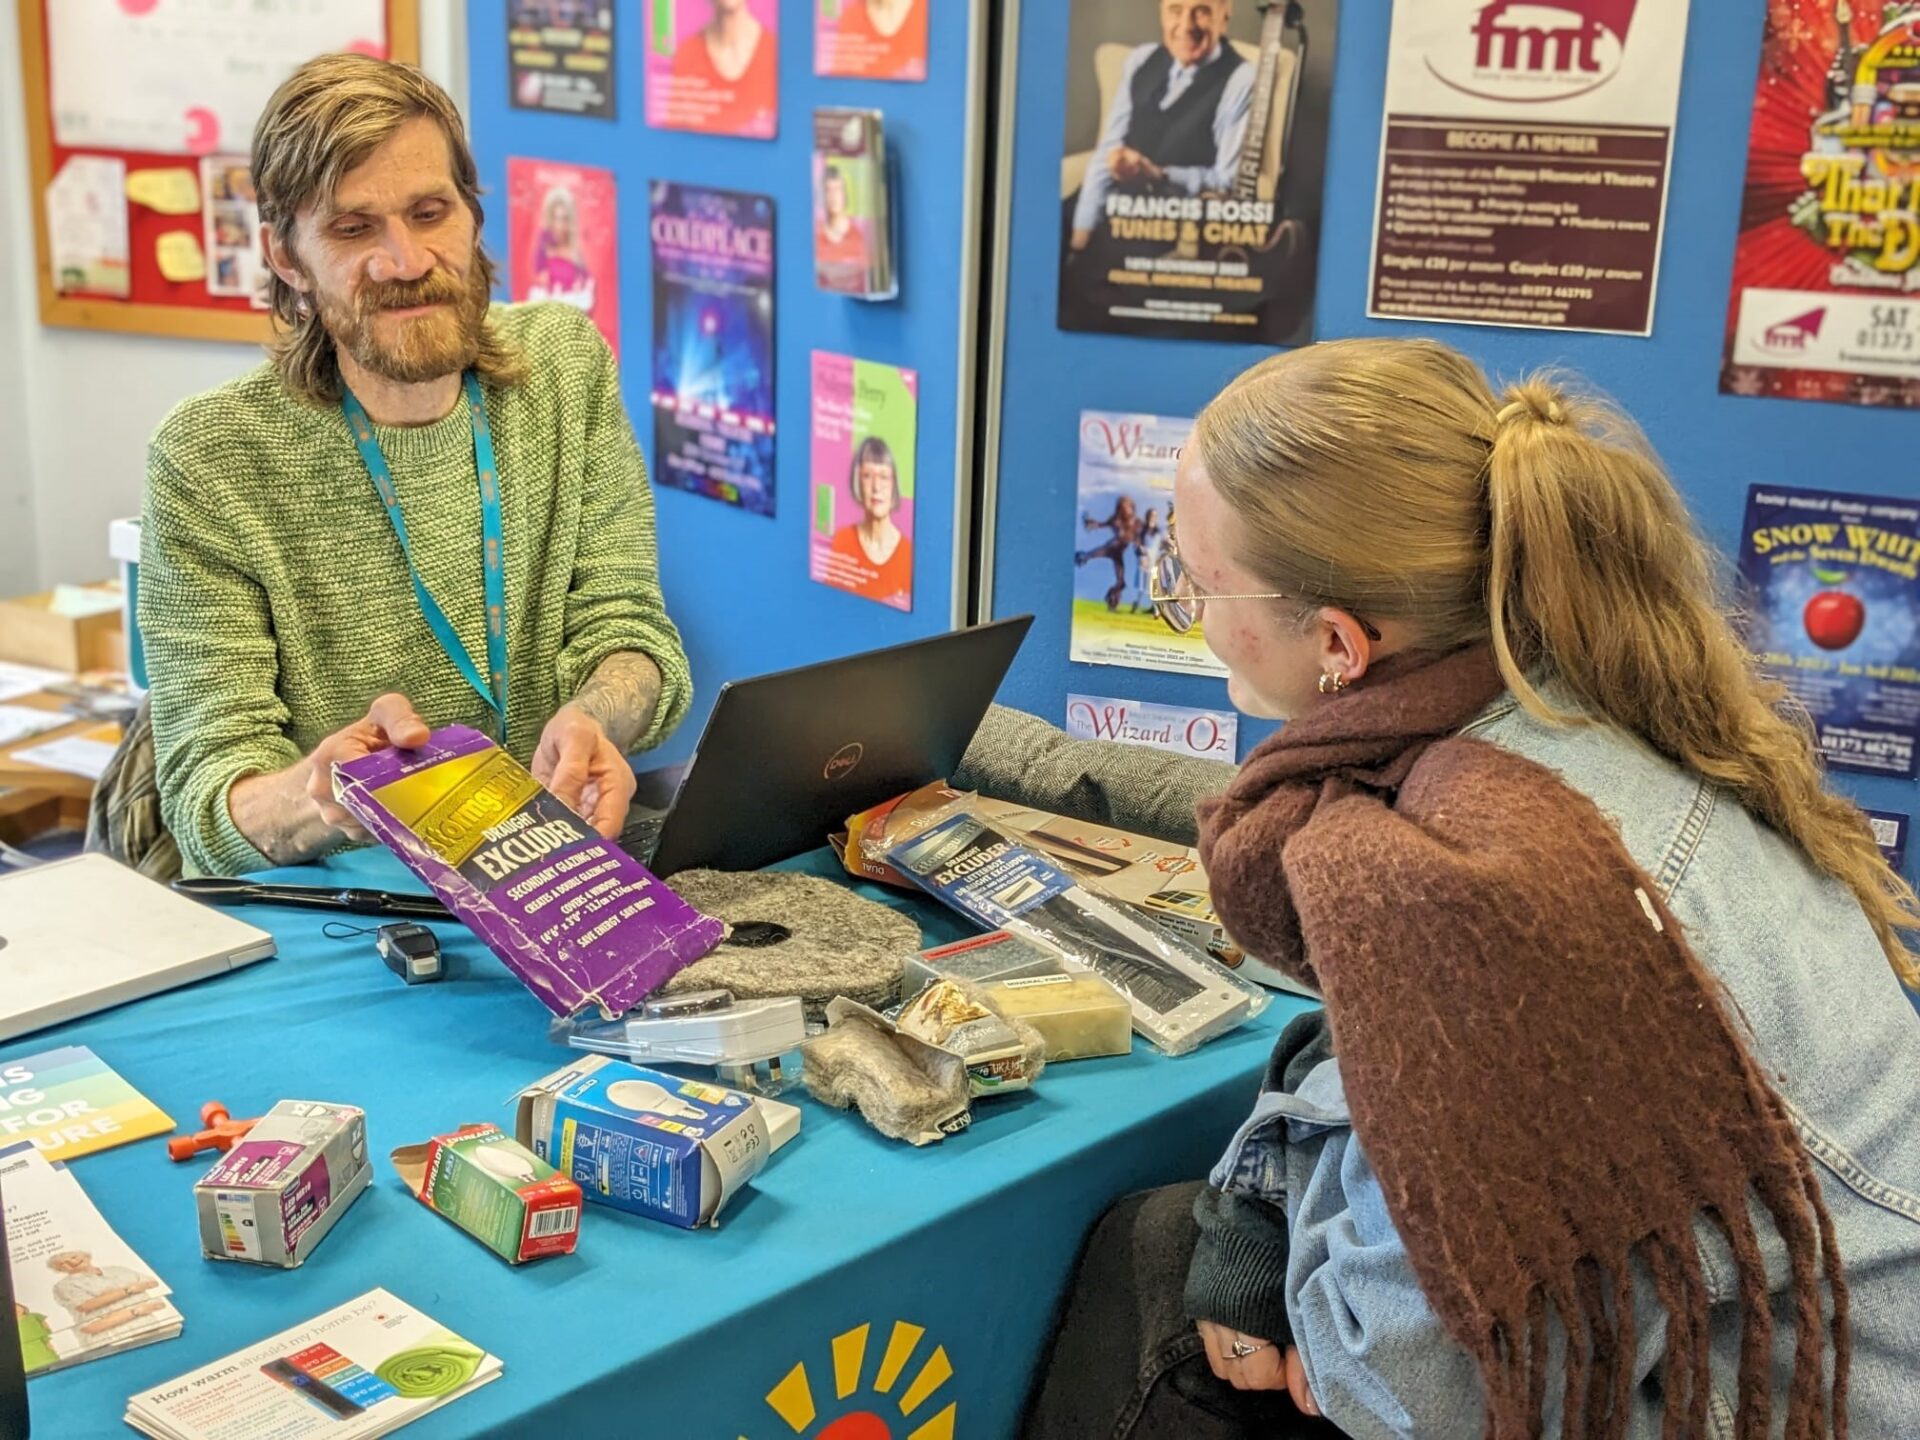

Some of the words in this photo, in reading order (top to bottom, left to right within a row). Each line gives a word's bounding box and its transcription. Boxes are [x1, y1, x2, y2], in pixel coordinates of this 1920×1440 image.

[1515, 133, 1530, 150] A
[1105, 193, 1204, 220] FRANCIS
[1206, 199, 1275, 224] ROSSI
[1109, 216, 1177, 242] TUNES
[1203, 221, 1270, 246] CHAT
[1870, 306, 1909, 329] SAT
[1752, 523, 1841, 555] SNOW
[1069, 702, 1172, 744] Wizard
[1186, 715, 1229, 752] Oz
[481, 811, 537, 843] DRAUGHT
[472, 819, 586, 881] EXCLUDER
[934, 841, 1010, 886] EXCLUDER
[944, 846, 982, 868] DRAUGHT
[506, 866, 559, 901] SECONDARY
[554, 851, 592, 873] GLAZING
[862, 862, 885, 876] DUAL
[964, 858, 1006, 883] LETTERBOX
[524, 892, 554, 914] CREATES
[550, 885, 561, 898] A
[556, 875, 583, 894] DOUBLE
[578, 865, 607, 882] GLAZING
[954, 874, 992, 897] DRAUGHT
[560, 893, 588, 914] COVERS
[577, 930, 596, 948] SAVE
[593, 914, 622, 937] ENERGY
[618, 905, 639, 919] SAVE
[2, 1099, 99, 1134] FOR
[445, 1127, 496, 1144] EVEREADY
[425, 1145, 445, 1200] EVEREADY
[150, 1382, 189, 1406] How
[191, 1365, 239, 1388] warm
[239, 1343, 288, 1367] should
[288, 1331, 312, 1348] my
[312, 1314, 353, 1336] home
[351, 1299, 378, 1318] be?
